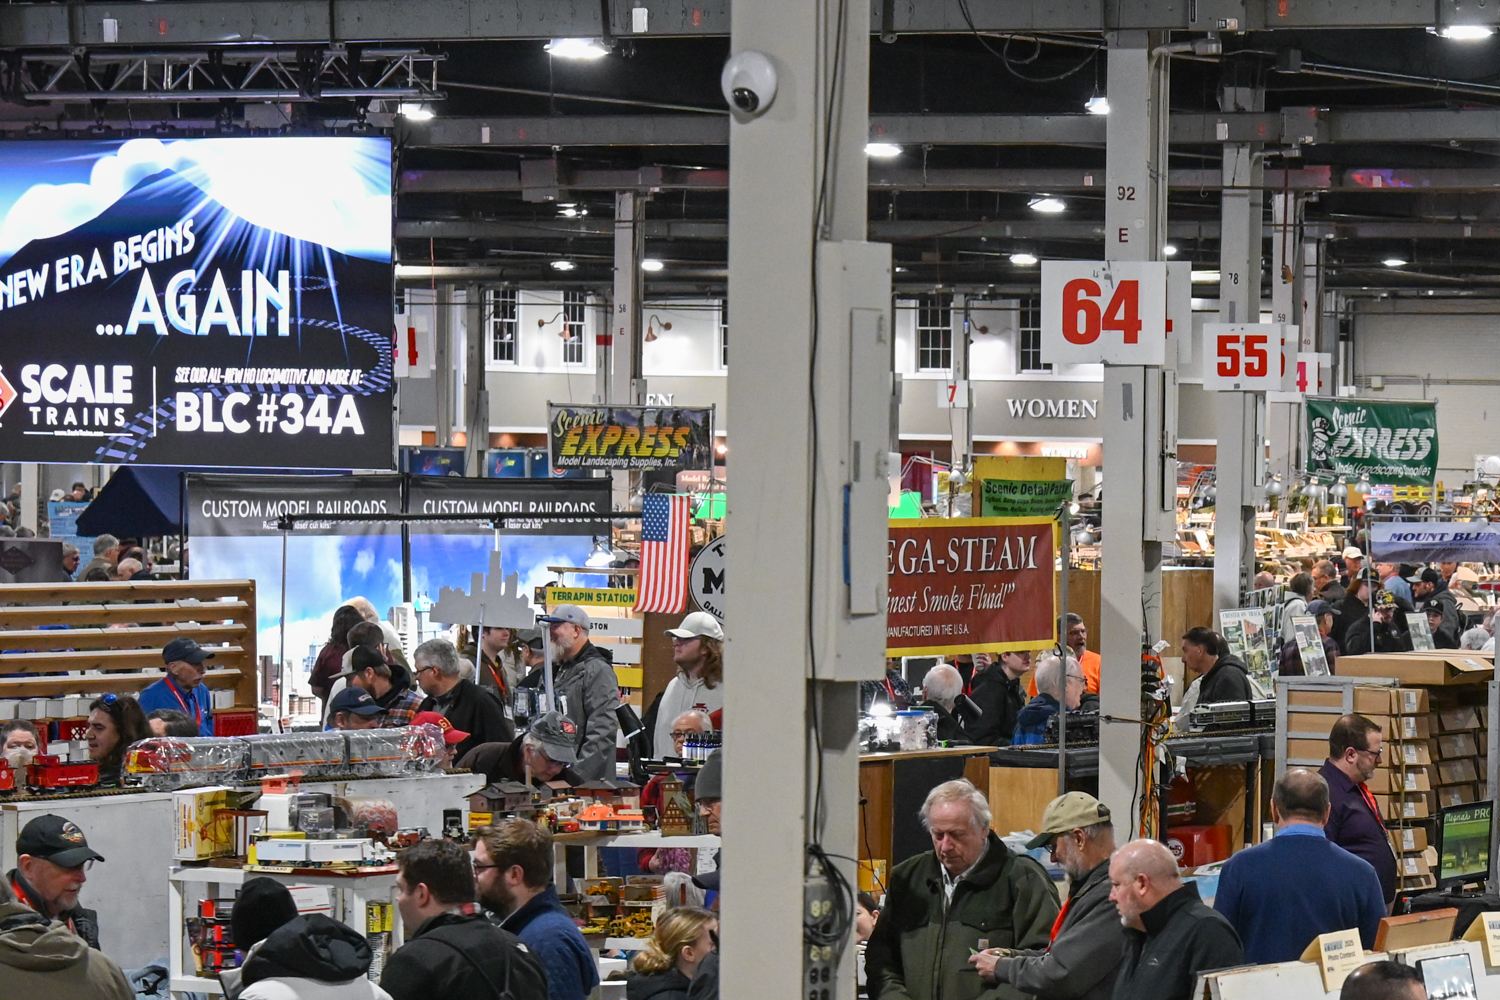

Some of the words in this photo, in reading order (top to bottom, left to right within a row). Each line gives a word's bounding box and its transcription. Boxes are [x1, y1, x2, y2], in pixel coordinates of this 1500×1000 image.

[1117, 186, 1135, 200] 92
[1118, 227, 1129, 243] E
[0, 263, 49, 311] NEW
[56, 248, 107, 293] ERA
[113, 219, 195, 272] BEGINS
[1062, 278, 1142, 346] 64
[1217, 335, 1267, 377] 55
[21, 364, 133, 404] SCALE
[175, 367, 190, 383] SEE
[190, 367, 208, 384] OUR
[207, 367, 244, 384] ALL-NEW
[244, 368, 256, 384] HO
[256, 368, 307, 384] LOCOMOTIVE
[306, 369, 325, 385] AND
[325, 369, 350, 385] MORE
[646, 393, 674, 407] EN
[948, 385, 956, 402] 7
[29, 407, 125, 427] TRAINS
[176, 393, 250, 434] BLC
[256, 393, 365, 435] #34A
[1007, 399, 1098, 419] WOMEN
[554, 409, 604, 437] Scenic
[1329, 407, 1366, 436] Scenic
[561, 426, 690, 457] EXPRESS
[1333, 427, 1435, 460] EXPRESS
[558, 456, 580, 466] Model
[582, 457, 628, 467] Landscaping
[630, 457, 662, 467] Supplies,
[1334, 463, 1355, 474] Model
[985, 481, 1017, 494] Scenic
[1021, 483, 1049, 496] Detail
[201, 499, 262, 518] CUSTOM
[266, 500, 310, 517] MODEL
[316, 500, 387, 514] RAILROADS
[423, 500, 478, 514] CUSTOM
[482, 500, 523, 514] MODEL
[529, 500, 596, 514] RAILROADS
[1389, 532, 1447, 542] MOUNT
[1451, 532, 1496, 543] BLUE
[888, 536, 1038, 575] EGA-STEAM
[552, 592, 593, 602] TERRAPIN
[597, 592, 635, 602] STATION
[887, 588, 916, 613] inest
[920, 582, 965, 613] Smoke
[933, 626, 940, 637] IN
[942, 625, 953, 636] THE
